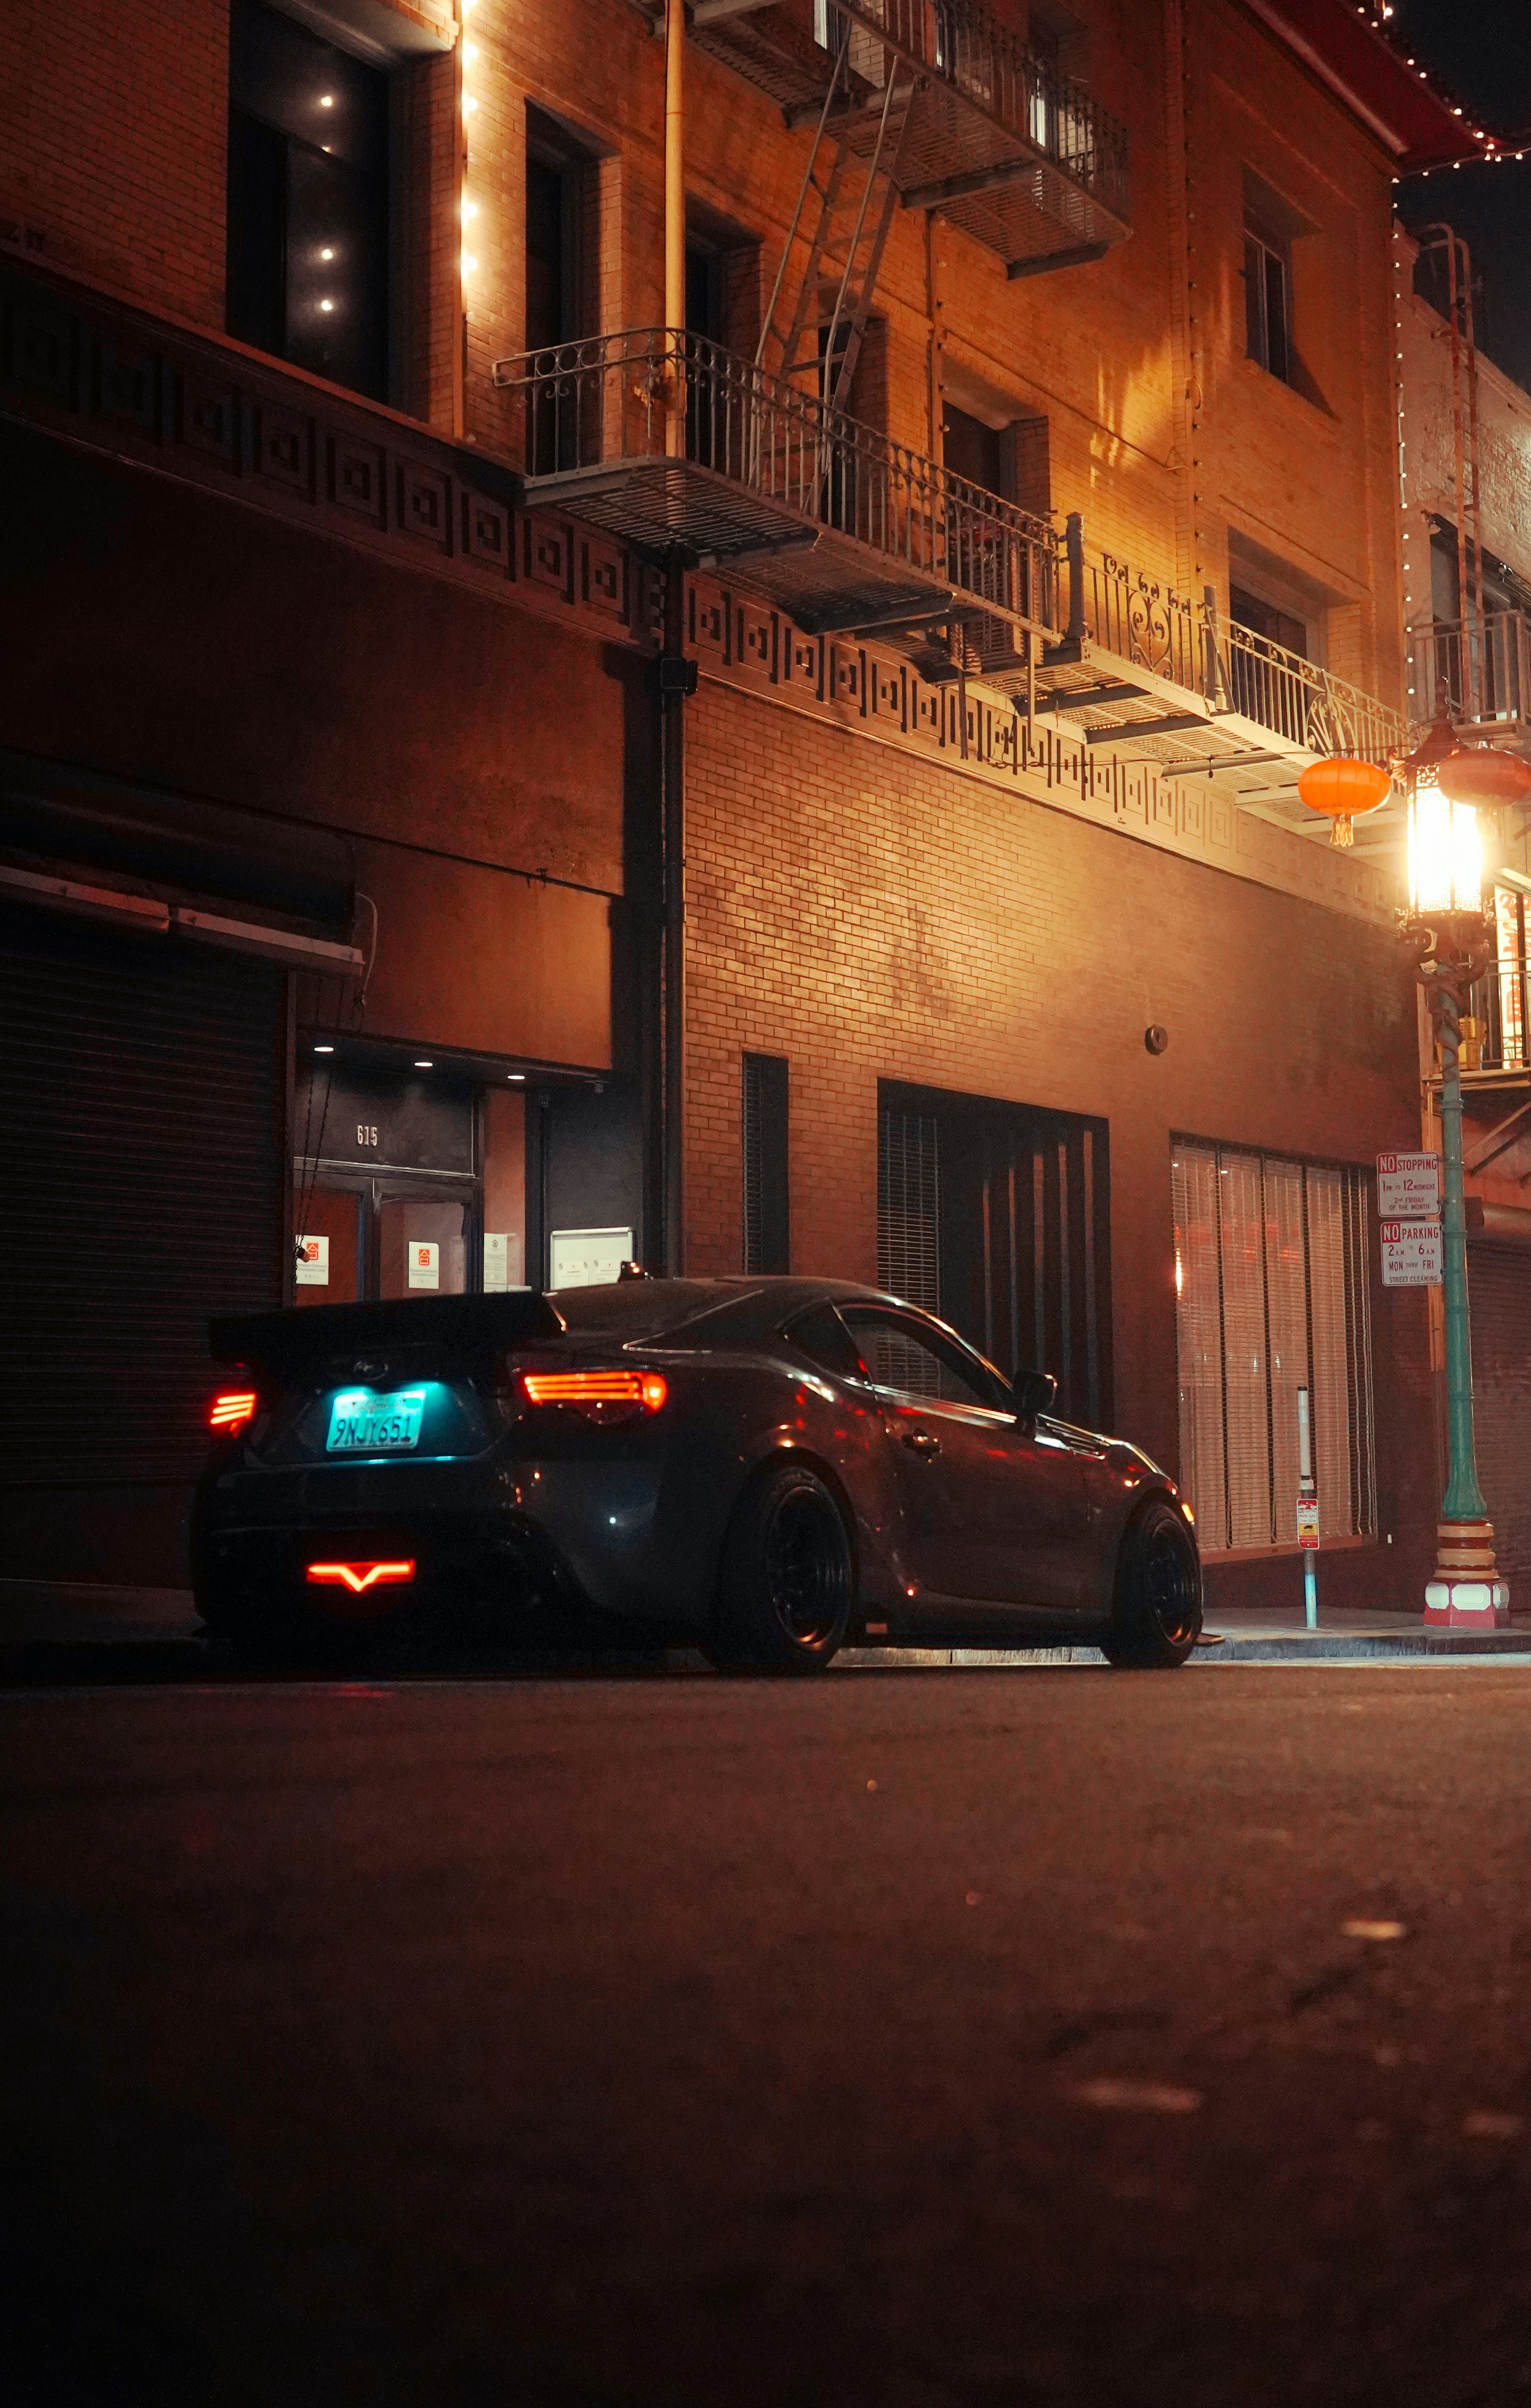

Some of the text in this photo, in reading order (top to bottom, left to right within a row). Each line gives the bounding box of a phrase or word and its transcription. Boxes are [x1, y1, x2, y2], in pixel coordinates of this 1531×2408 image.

[357, 1125, 377, 1146] 615
[1380, 1157, 1437, 1172] NO STOPPING
[1384, 1224, 1439, 1241] NO PARKING
[1389, 1261, 1403, 1271] MON
[1423, 1260, 1434, 1270] FRI
